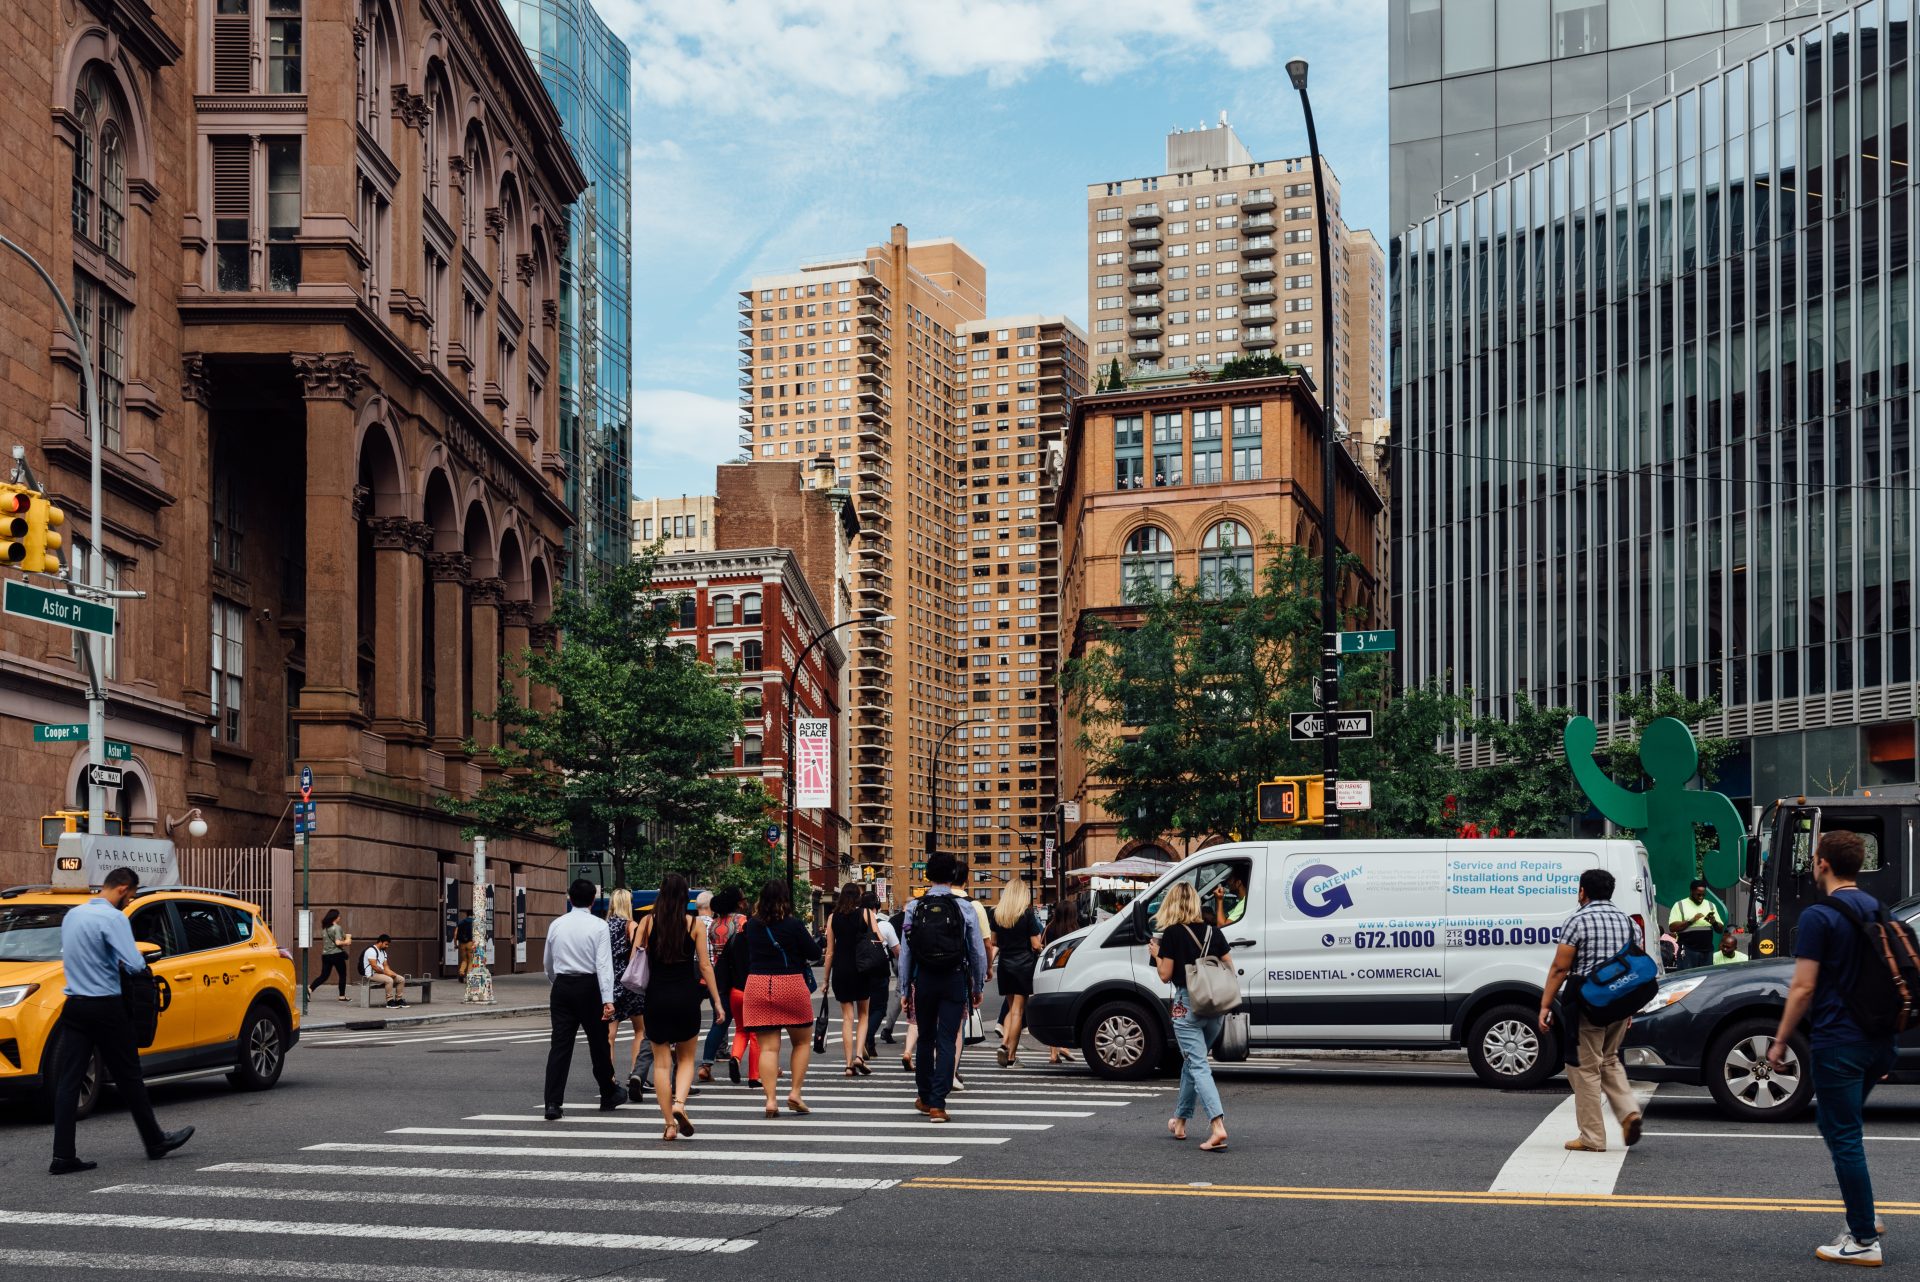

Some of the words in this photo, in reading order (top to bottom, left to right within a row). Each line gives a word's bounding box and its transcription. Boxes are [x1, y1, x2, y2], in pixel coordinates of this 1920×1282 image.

[42, 597, 69, 618] Astor
[72, 604, 82, 622] Pl
[1356, 634, 1364, 650] 3
[1368, 633, 1378, 643] Av
[799, 722, 828, 730] ASTOR
[1303, 721, 1324, 731] ONE
[1337, 720, 1361, 730] WAY
[44, 726, 70, 740] Cooper
[72, 726, 79, 735] Sq
[108, 744, 122, 758] Astor
[93, 770, 104, 780] ONE
[107, 772, 119, 782] WAY
[96, 848, 167, 864] PARACHUTE
[61, 858, 79, 870] 1K57
[99, 863, 112, 871] VERY
[1453, 860, 1494, 870] Service
[1496, 860, 1517, 870] and
[1520, 860, 1562, 872] Repairs
[1313, 865, 1364, 894] GATEWAY
[1452, 873, 1519, 882] Installations
[1522, 873, 1543, 882] and
[1546, 873, 1580, 884] Upgra
[1452, 885, 1486, 895] Steam
[1489, 885, 1515, 895] Heat
[1517, 885, 1578, 896] Specialists
[1358, 917, 1523, 929] www.GatewayPlumbing.com
[1354, 930, 1435, 949] 672.1000
[1446, 930, 1463, 938] 212
[1464, 926, 1562, 946] 980.0909
[1447, 938, 1463, 946] 718
[1268, 969, 1348, 981] RESIDENTIAL
[1357, 968, 1442, 979] COMMERCIAL
